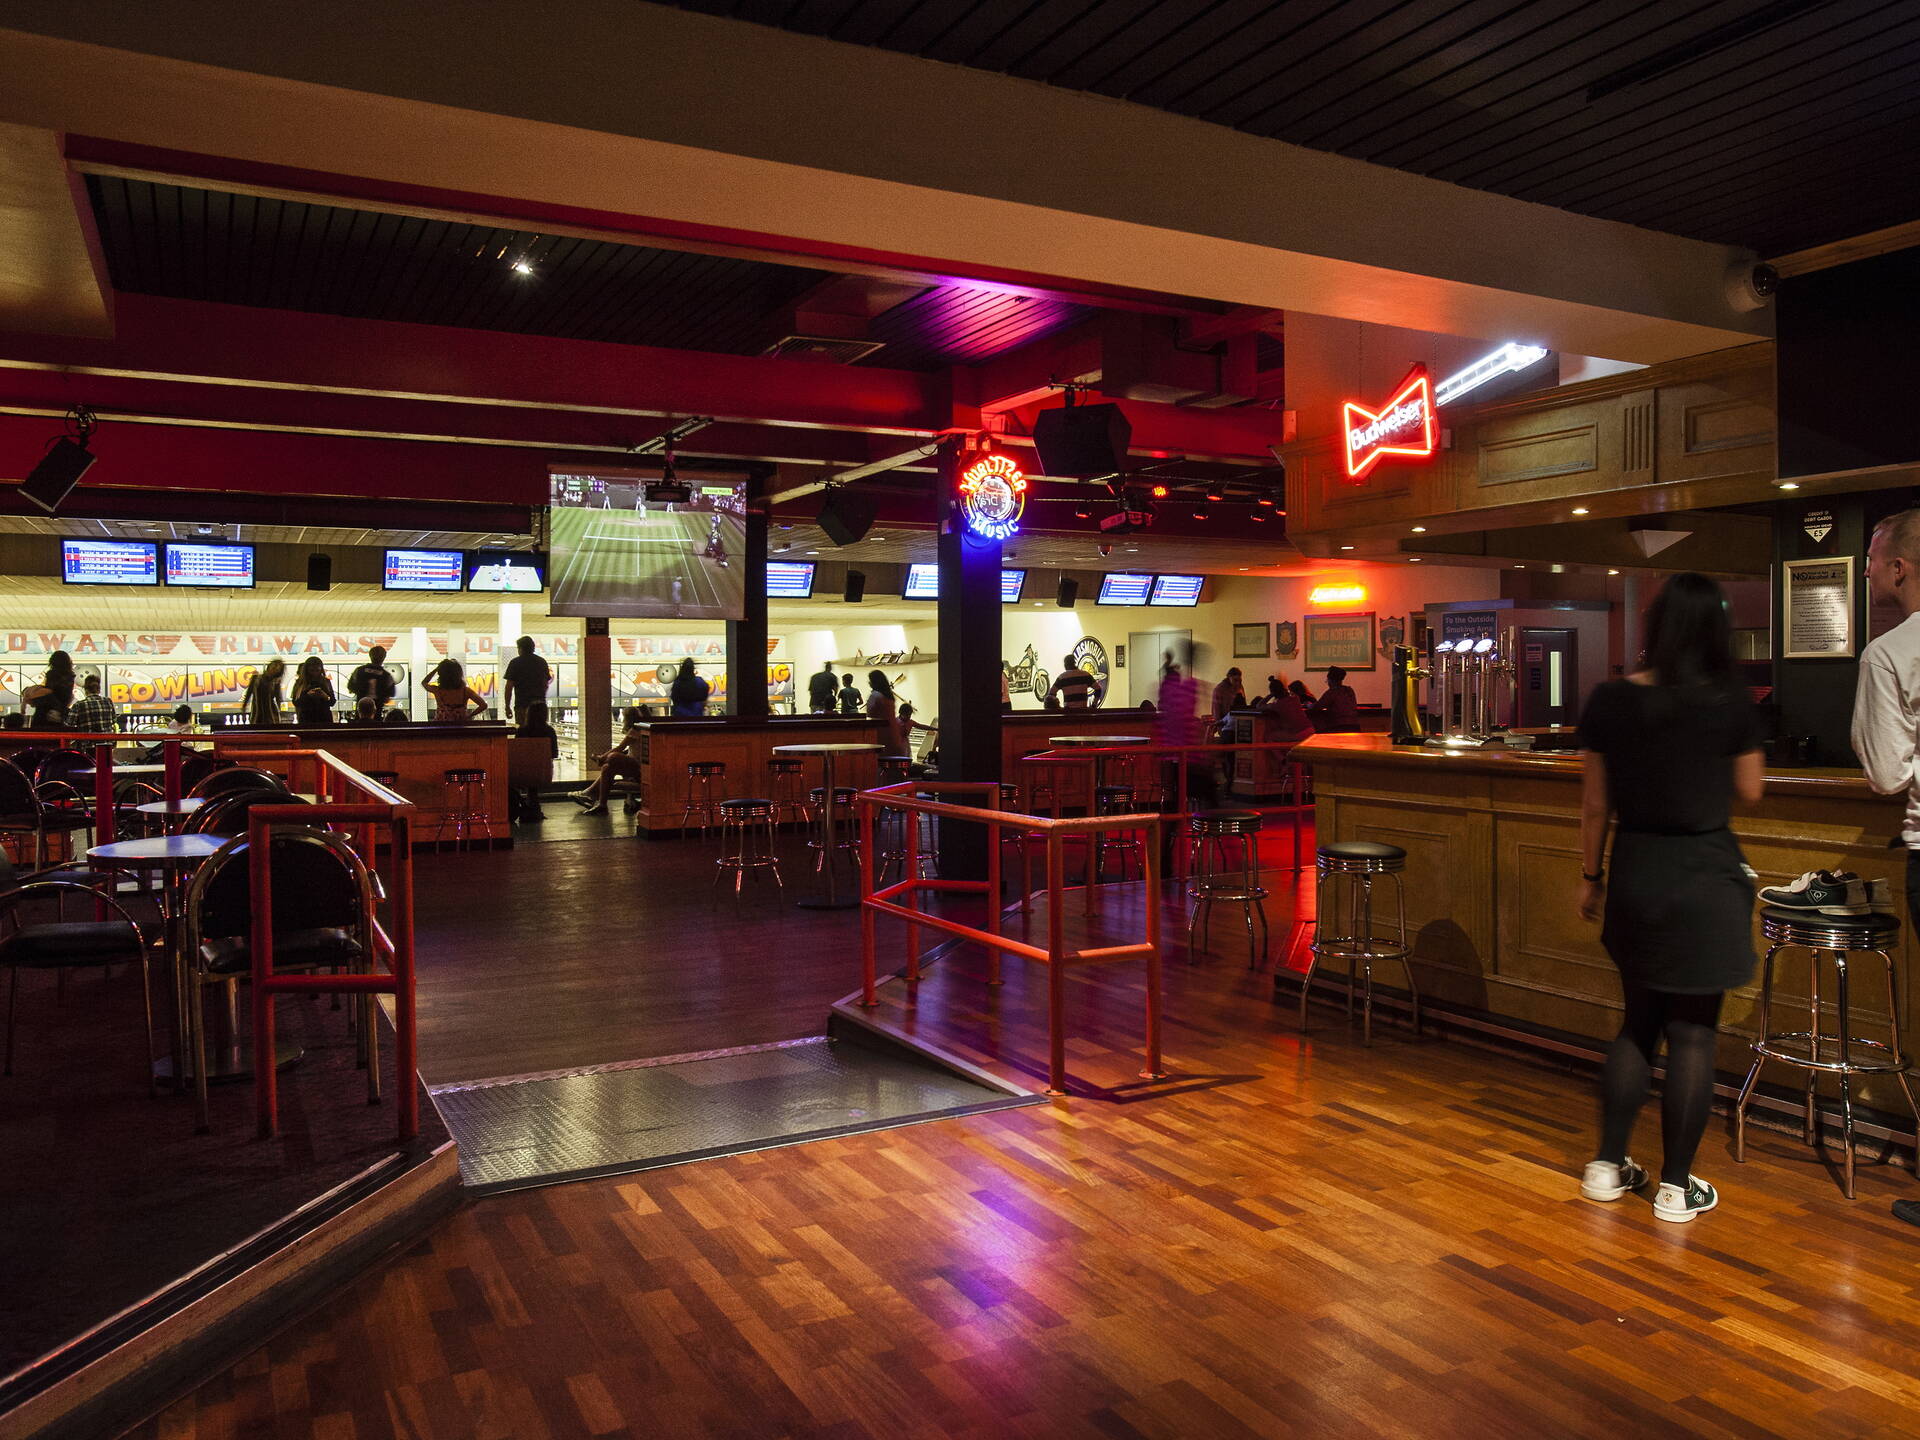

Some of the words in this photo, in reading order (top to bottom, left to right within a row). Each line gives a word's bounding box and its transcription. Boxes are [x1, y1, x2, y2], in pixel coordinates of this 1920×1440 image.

[1350, 399, 1424, 451] Budweiser
[970, 512, 1019, 540] MUSIC
[1445, 616, 1453, 624] To
[1468, 615, 1495, 623] Outside
[1446, 626, 1475, 634] Smoking
[8, 632, 155, 654] OWANS
[220, 634, 375, 655] ROWANS
[1073, 641, 1105, 667] LDSMOBILE
[110, 665, 257, 703] BOWLING
